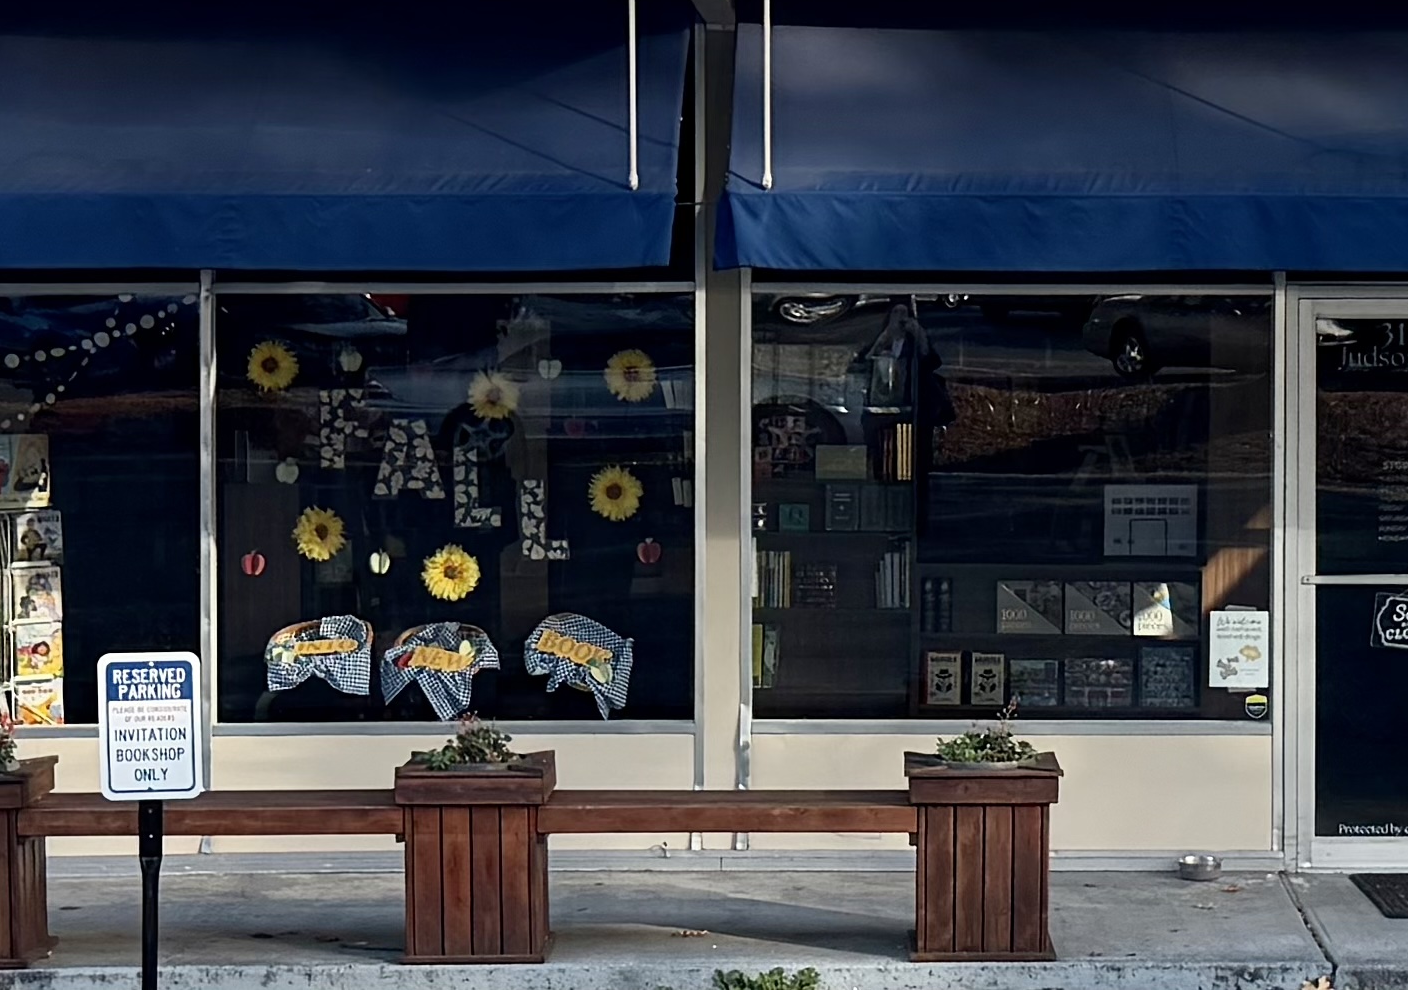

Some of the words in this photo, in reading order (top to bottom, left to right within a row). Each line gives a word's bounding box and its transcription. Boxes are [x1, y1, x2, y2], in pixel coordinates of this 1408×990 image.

[112, 667, 186, 684] RESERVED
[118, 683, 182, 700] PARKING
[114, 727, 187, 742] INVITATION
[116, 747, 185, 762] BOOKSHOP
[134, 768, 169, 782] ONLY
[1338, 823, 1389, 834] Protected
[1390, 823, 1403, 836] by
